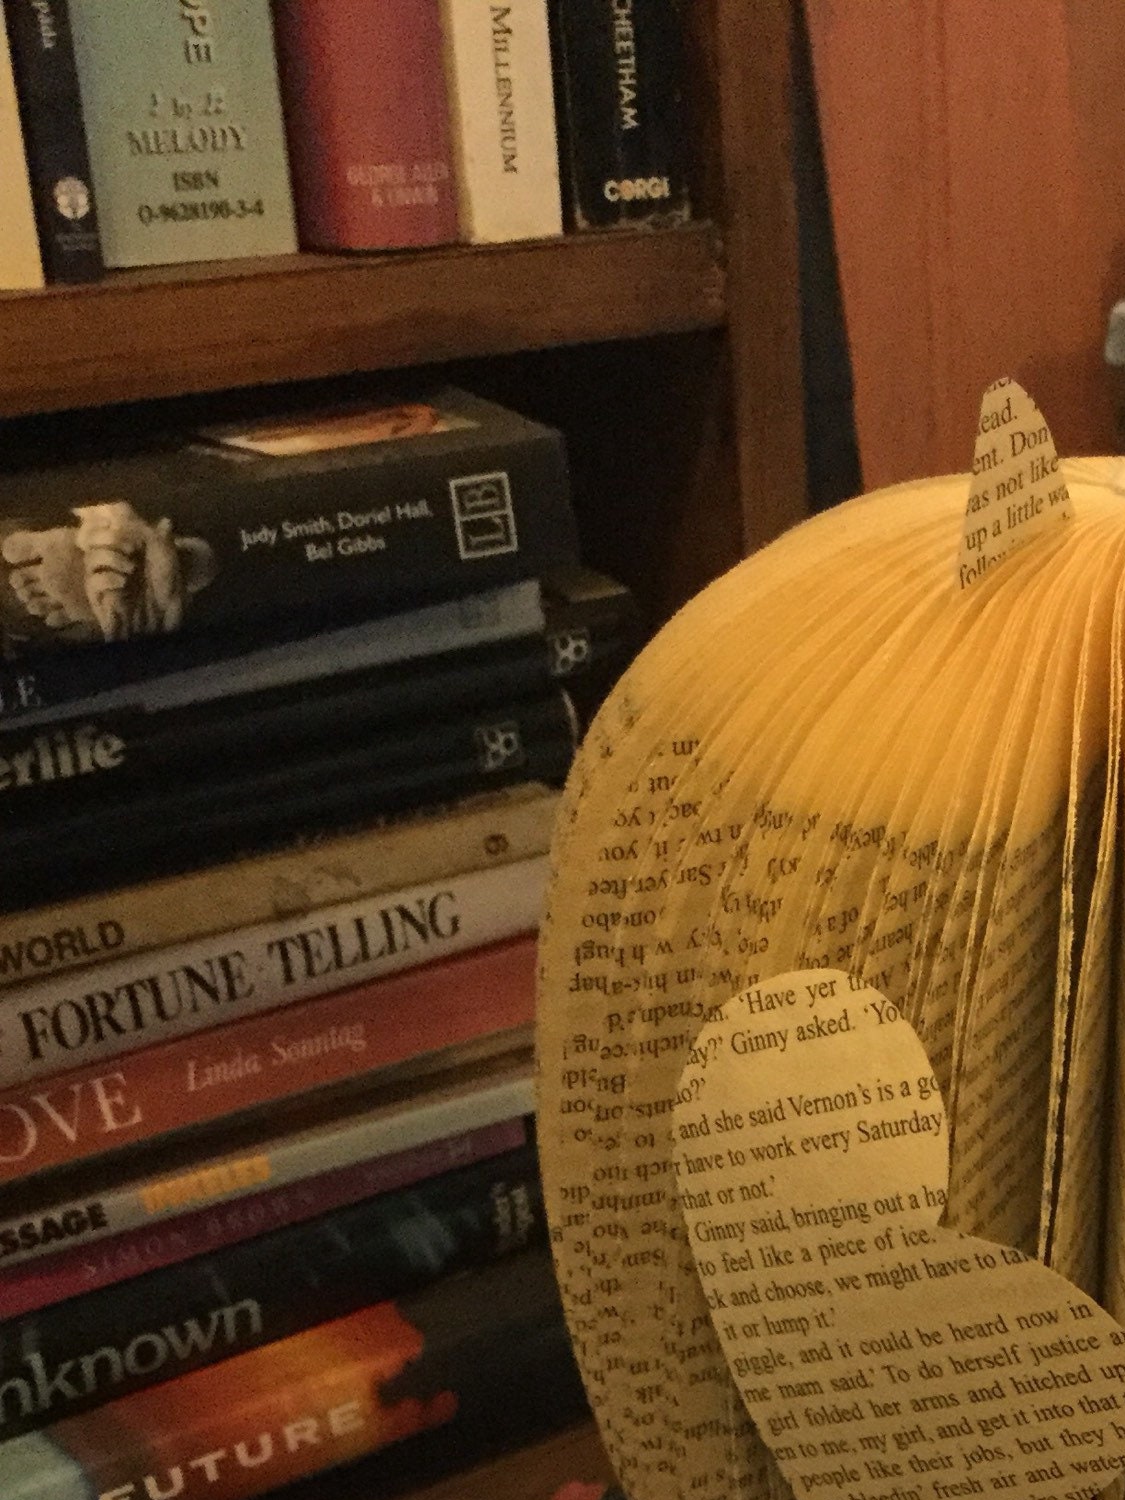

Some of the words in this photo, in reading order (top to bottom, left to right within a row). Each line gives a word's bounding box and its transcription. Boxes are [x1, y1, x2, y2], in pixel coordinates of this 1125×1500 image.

[489, 8, 518, 172] MILLENNIUM
[126, 124, 245, 156] MELODY
[171, 168, 219, 192] ISBN
[601, 177, 670, 201] CORGI
[994, 470, 1024, 501] not
[1028, 454, 1059, 484] like
[239, 525, 277, 552] Judy
[334, 528, 386, 558] Gibbs
[964, 525, 988, 553] up
[990, 518, 1002, 538] a
[1005, 493, 1044, 530] little
[18, 955, 257, 1060] FORTUNE
[268, 892, 462, 986] TELLING
[729, 1028, 789, 1055] Ginny
[795, 1011, 857, 1042] asked.
[186, 1051, 262, 1092] Linda
[677, 1112, 712, 1141] and
[713, 1109, 744, 1134] she
[747, 1097, 786, 1128] said
[785, 1082, 872, 1117] Vernon's
[875, 1077, 895, 1103] is
[898, 1079, 912, 1098] a
[682, 1152, 725, 1175] have
[725, 1147, 747, 1167] to
[748, 1134, 797, 1162] work
[798, 1129, 850, 1154] every
[855, 1108, 943, 1144] Saturday
[692, 1219, 746, 1244] Ginny
[748, 1207, 791, 1236] said,
[789, 1201, 872, 1229] bringing
[872, 1194, 905, 1216] out
[907, 1193, 921, 1210] a
[731, 1346, 795, 1378] giggle,
[797, 1341, 834, 1364] and
[835, 1337, 854, 1359] it
[858, 1328, 914, 1356] could
[914, 1327, 944, 1348] be
[946, 1312, 1010, 1343] heard
[1014, 1309, 1059, 1331] now
[1065, 1299, 1094, 1320] in
[802, 1400, 866, 1427] folded
[867, 1398, 902, 1419] her
[908, 1391, 961, 1413] arms
[966, 1379, 1006, 1404] and
[1007, 1362, 1094, 1395] hitched
